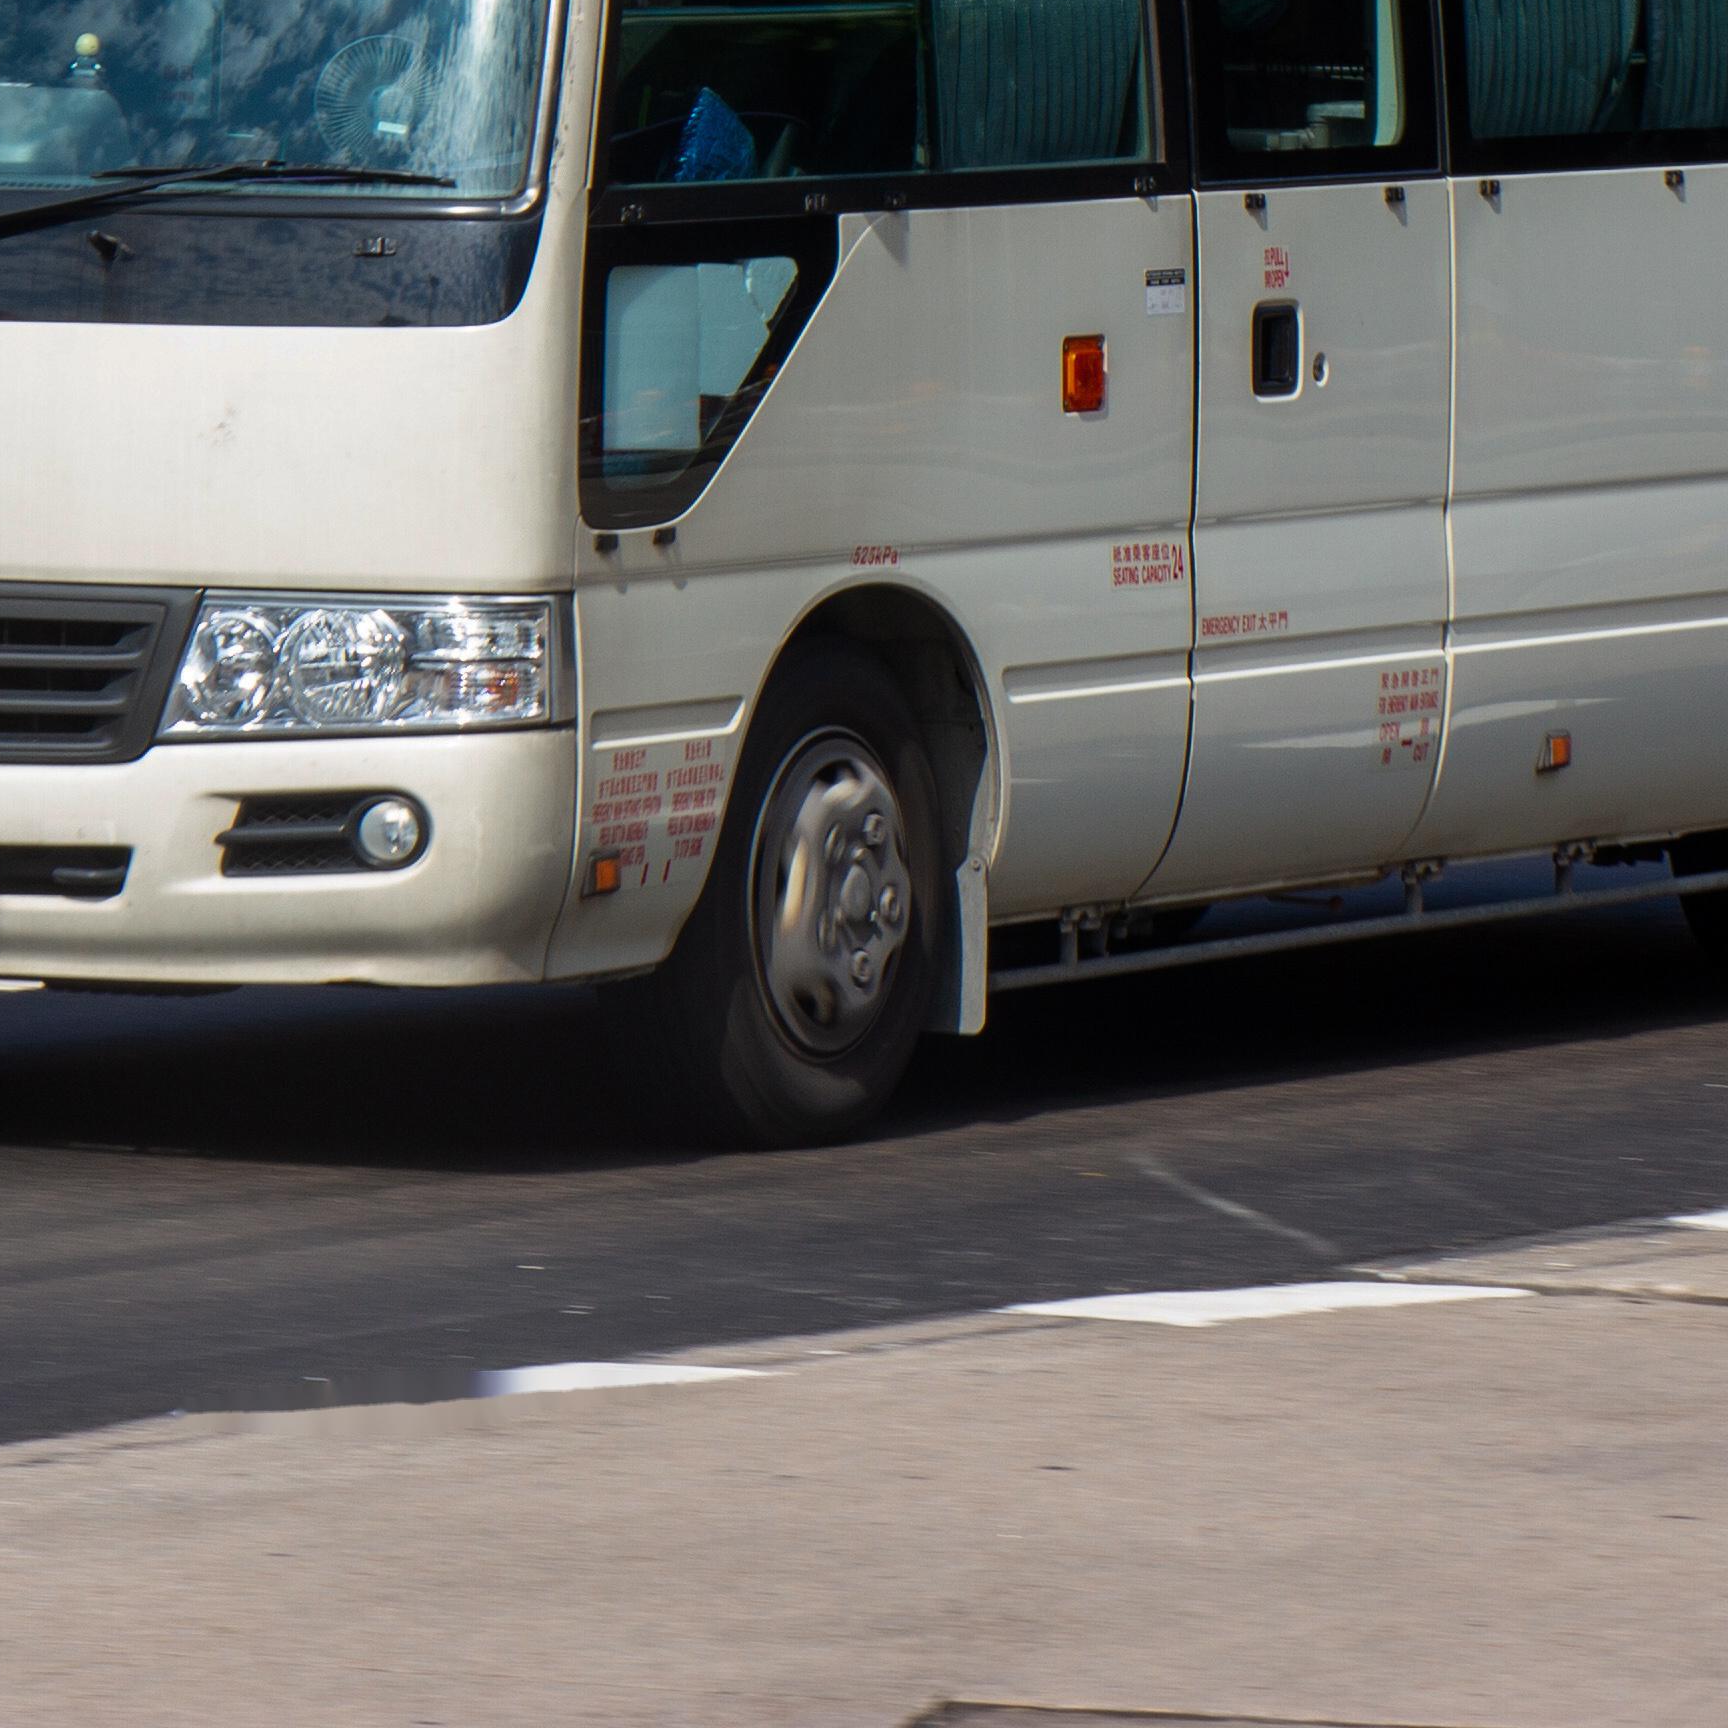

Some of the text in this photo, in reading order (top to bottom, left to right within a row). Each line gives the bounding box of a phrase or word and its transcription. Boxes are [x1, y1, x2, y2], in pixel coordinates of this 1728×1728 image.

[1171, 543, 1184, 580] 24
[1113, 564, 1171, 587] SEATING CAPACITY
[1202, 614, 1256, 636] EMERGENCY EXIT
